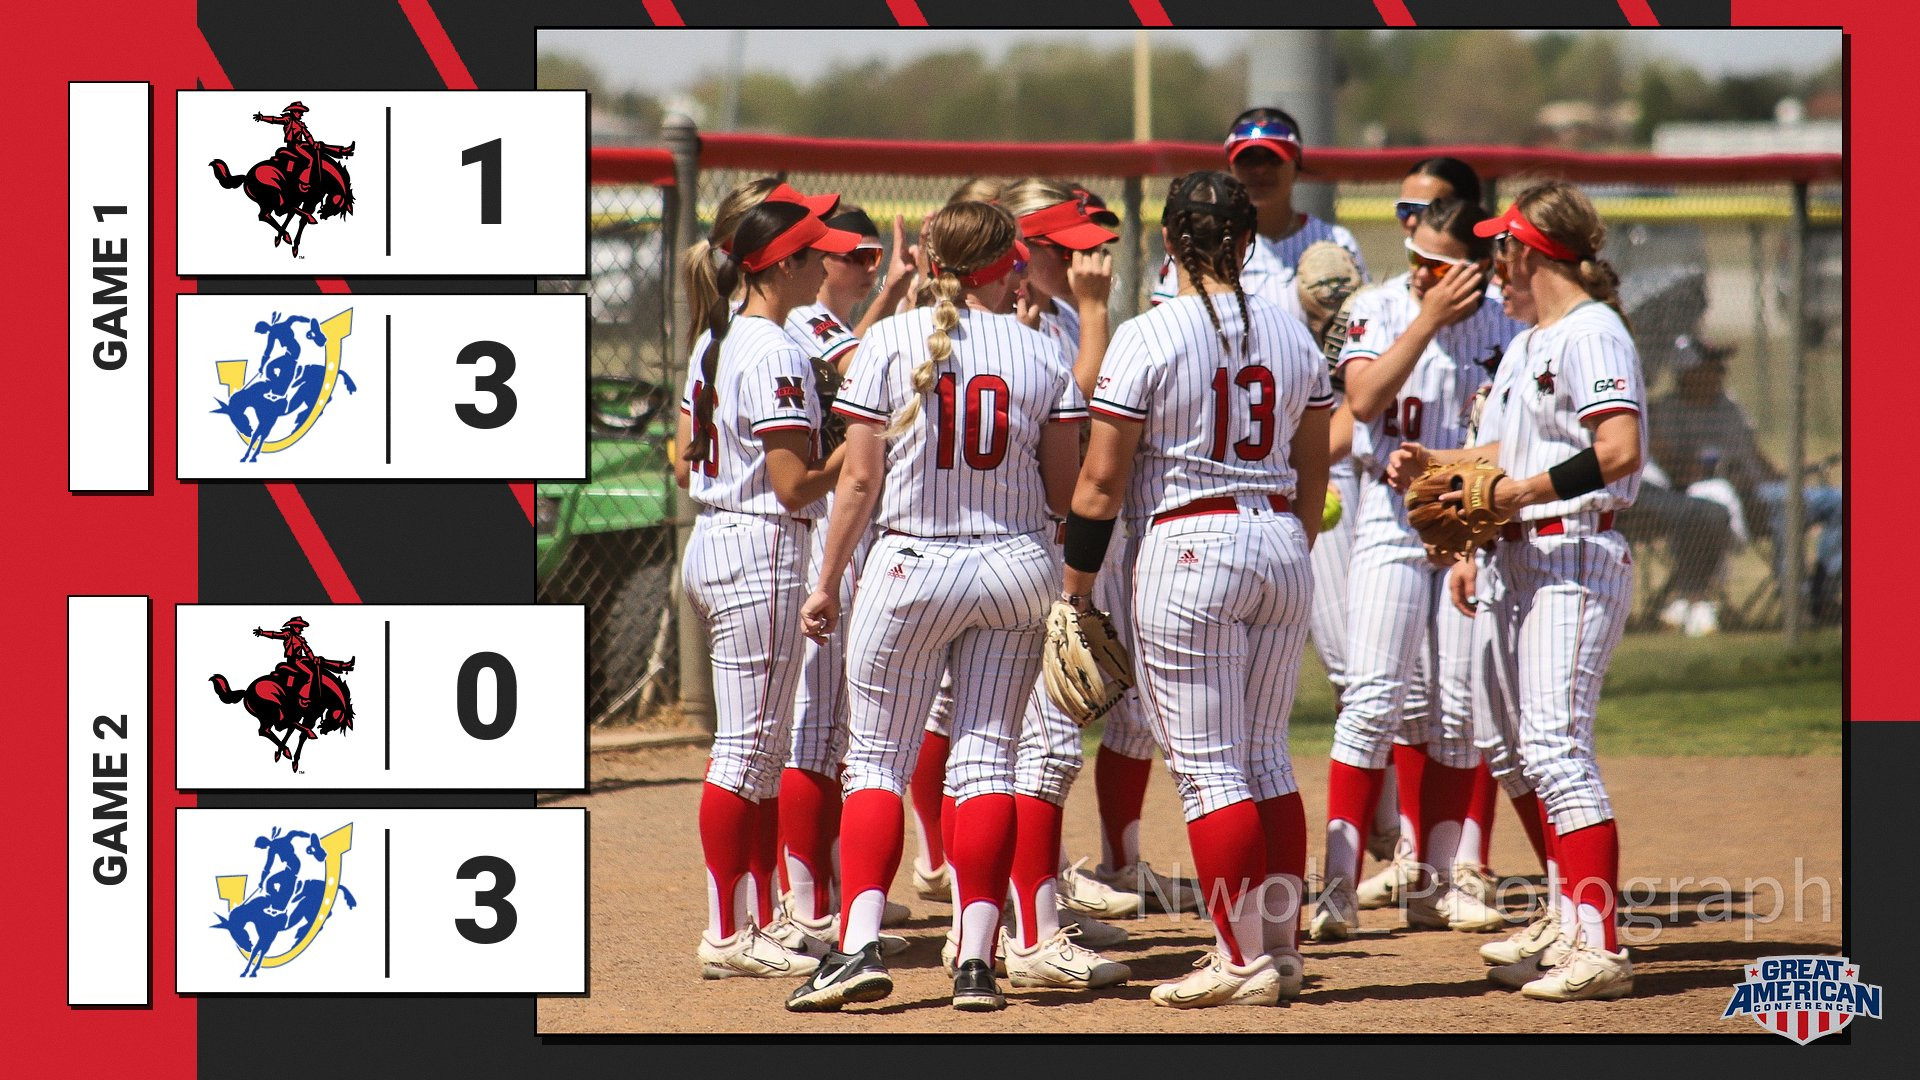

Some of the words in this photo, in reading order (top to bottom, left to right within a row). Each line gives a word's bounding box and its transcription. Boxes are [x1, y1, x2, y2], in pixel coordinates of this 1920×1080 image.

[934, 372, 1010, 471] 10
[1211, 365, 1276, 462] 13
[1594, 378, 1626, 393] GAC
